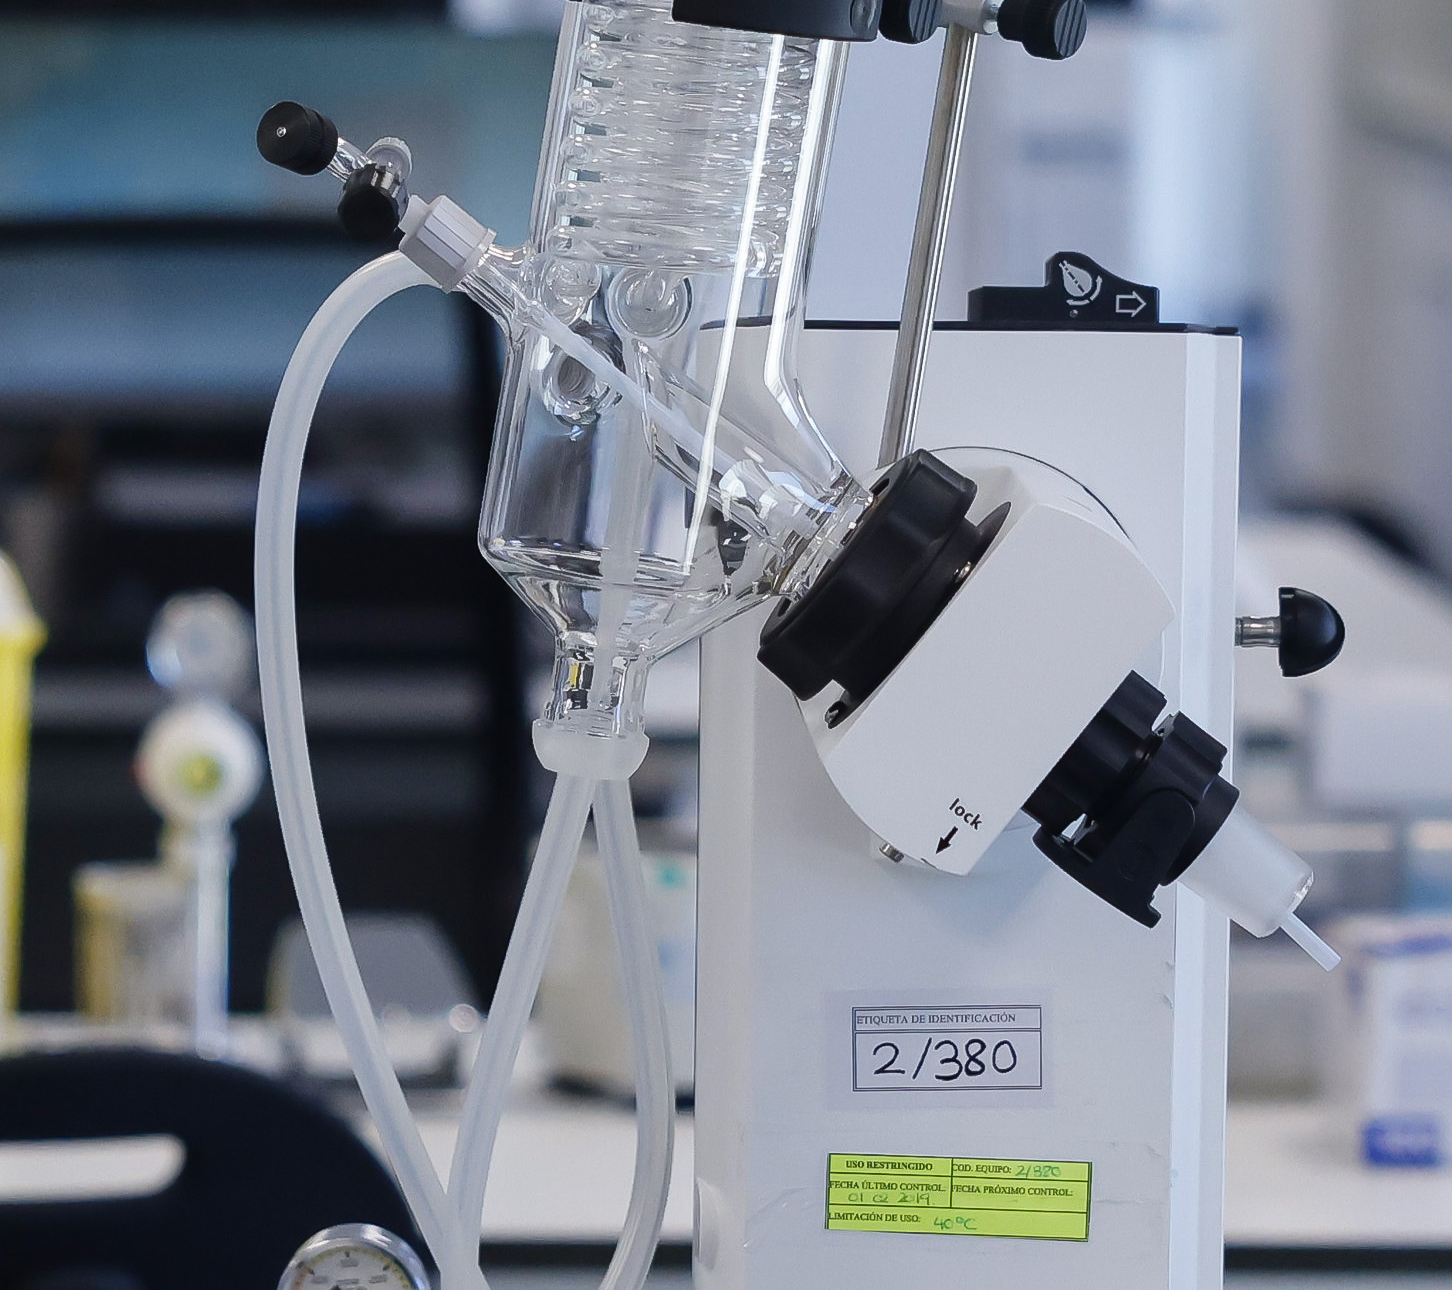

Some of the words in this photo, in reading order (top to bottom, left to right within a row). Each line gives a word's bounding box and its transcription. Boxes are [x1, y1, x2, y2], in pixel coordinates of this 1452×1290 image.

[949, 797, 983, 830] lock
[856, 1014, 908, 1025] ETIQUETA
[911, 1014, 927, 1025] DE
[928, 1011, 1016, 1024] IDENTIFICACIÓN
[872, 1037, 1018, 1081] 2/380
[846, 1160, 865, 1169] USO
[866, 1161, 933, 1171] RESTRINGIDO
[952, 1163, 973, 1173] COD.
[975, 1164, 1012, 1175] EQUIPO:
[829, 1180, 860, 1190] FECHA
[861, 1179, 898, 1191] ÚLTIMO
[983, 1184, 1026, 1195] PRÓXIMO
[1027, 1187, 1073, 1197] CONTROL:
[829, 1211, 883, 1222] LIMITACIÓN
[884, 1213, 898, 1222] DE
[899, 1214, 921, 1223] USO:
